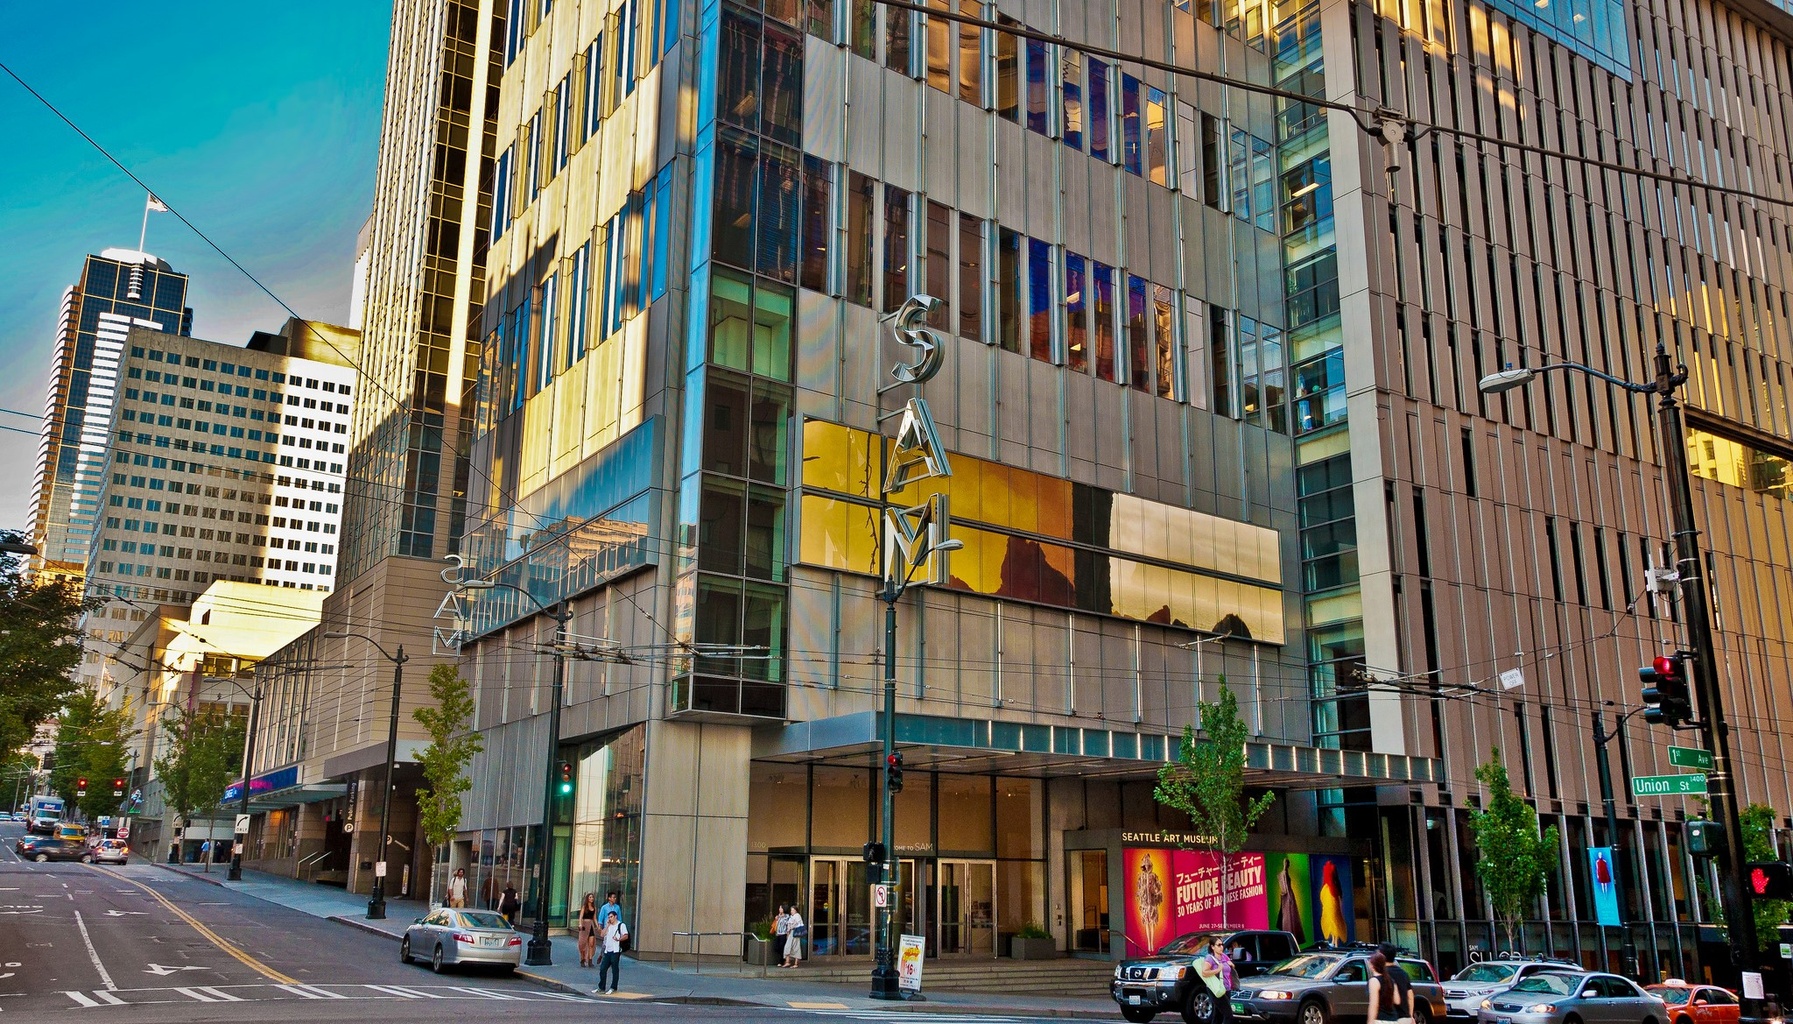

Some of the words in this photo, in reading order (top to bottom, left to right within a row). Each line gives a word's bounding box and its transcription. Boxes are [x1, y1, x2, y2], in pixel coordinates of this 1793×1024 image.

[883, 294, 951, 585] SAM
[1698, 754, 1708, 764] Ave
[1636, 780, 1670, 792] Union
[1680, 781, 1689, 791] St
[1122, 832, 1160, 843] SEATTLE
[1163, 834, 1180, 843] ART
[915, 842, 933, 851] SAM
[1177, 877, 1219, 905] FUTURE
[1178, 905, 1185, 917] 30
[1186, 900, 1203, 915] YEARS
[1204, 898, 1212, 909] OF
[1213, 890, 1239, 908] JAPNESE
[1240, 884, 1263, 900] FASHION
